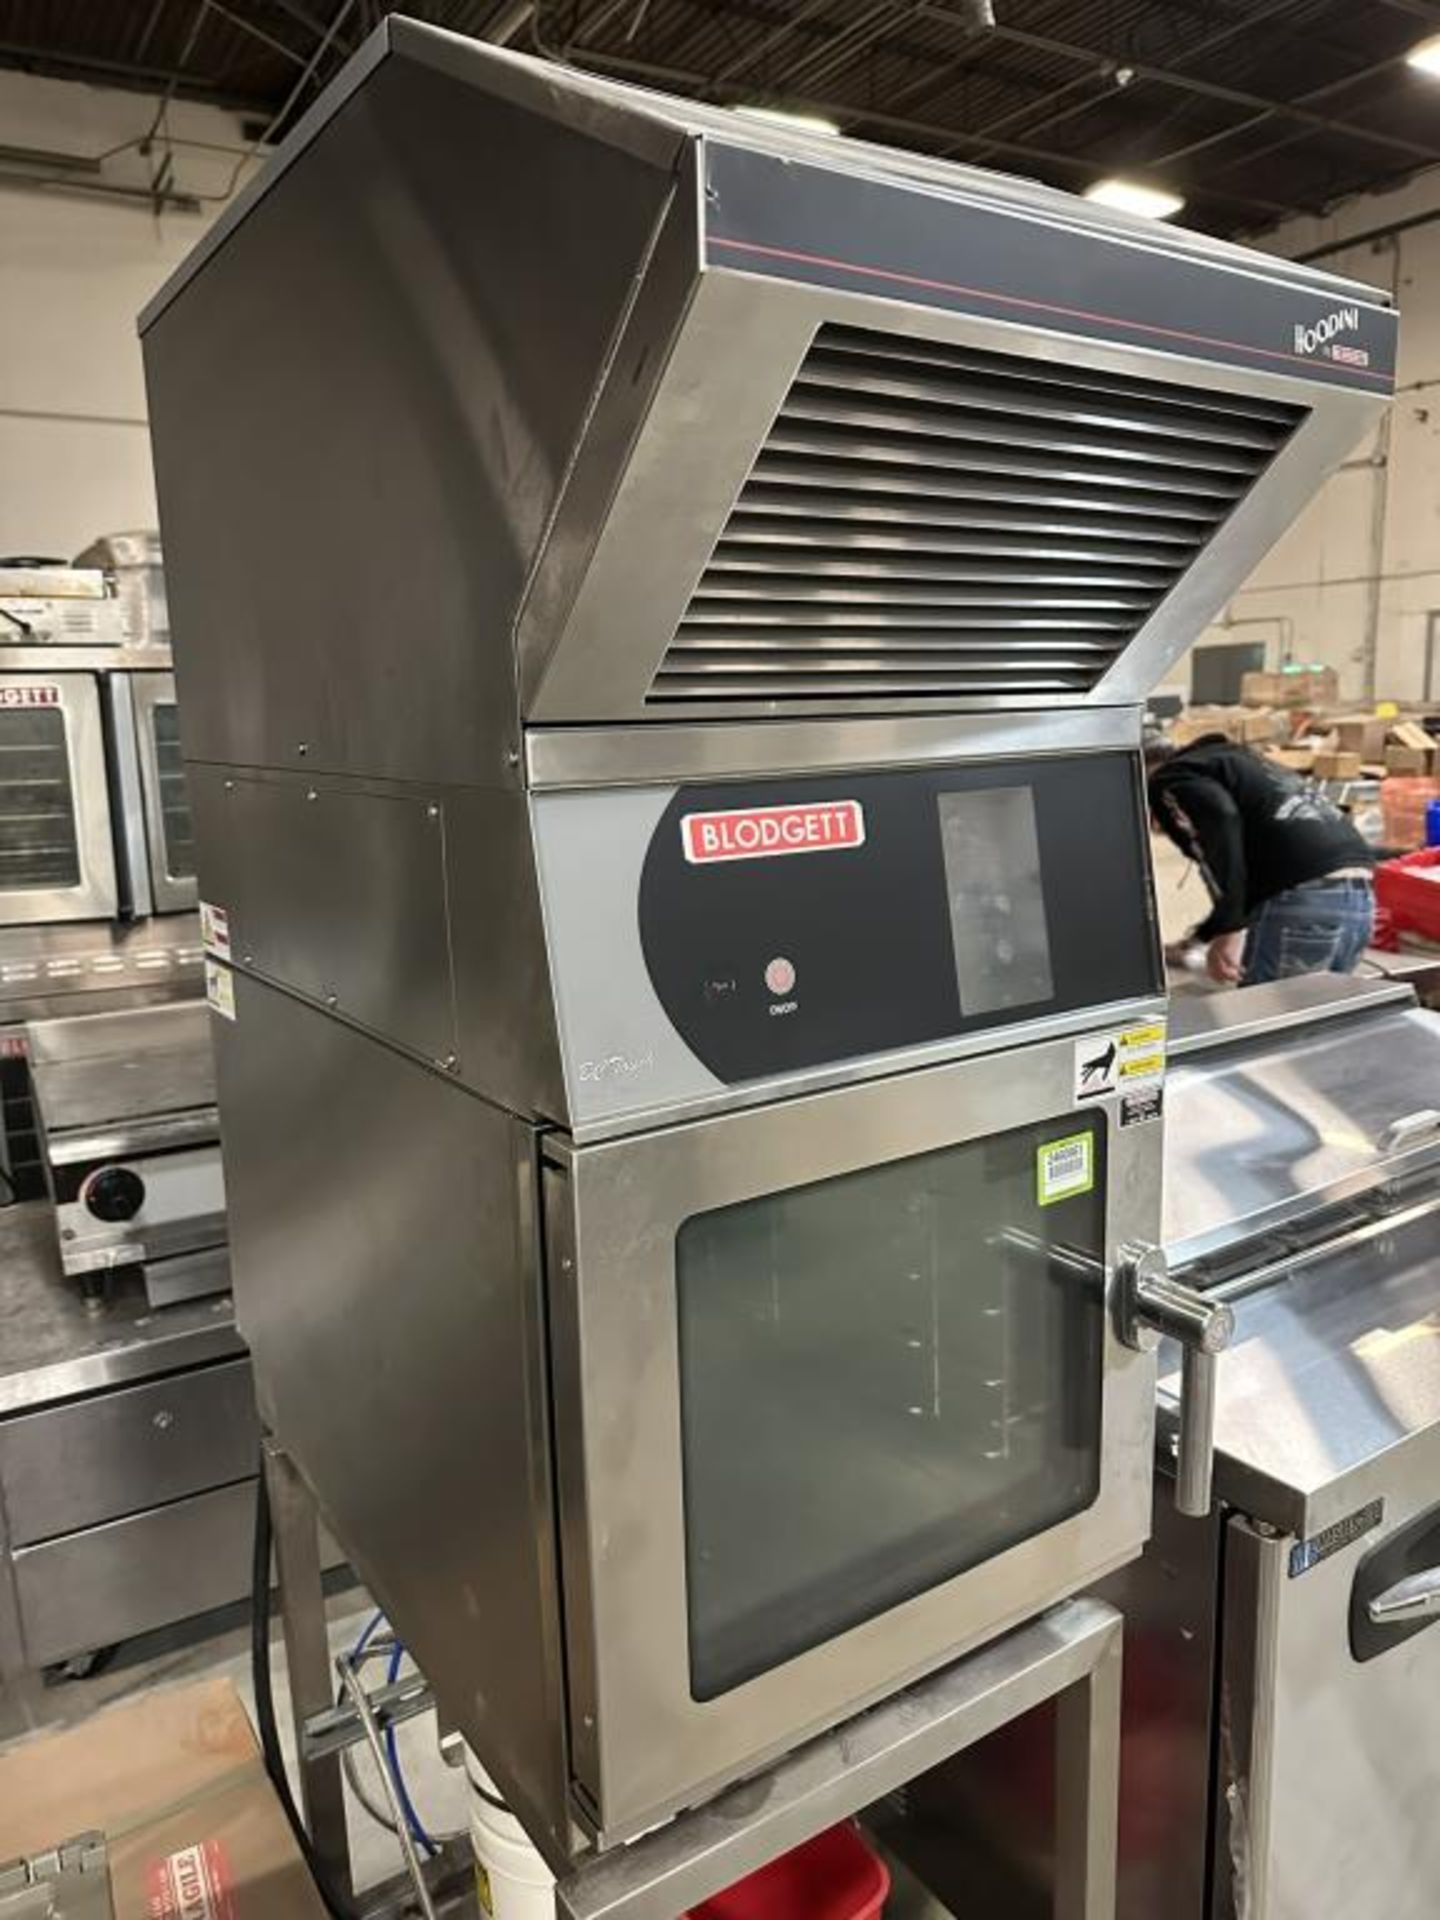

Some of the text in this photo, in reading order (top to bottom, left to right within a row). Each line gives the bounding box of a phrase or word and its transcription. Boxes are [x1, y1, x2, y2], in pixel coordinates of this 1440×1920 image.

[1294, 307, 1359, 354] HOODINI
[701, 811, 849, 852] BLODGETT
[177, 1853, 206, 1920] AGILE
